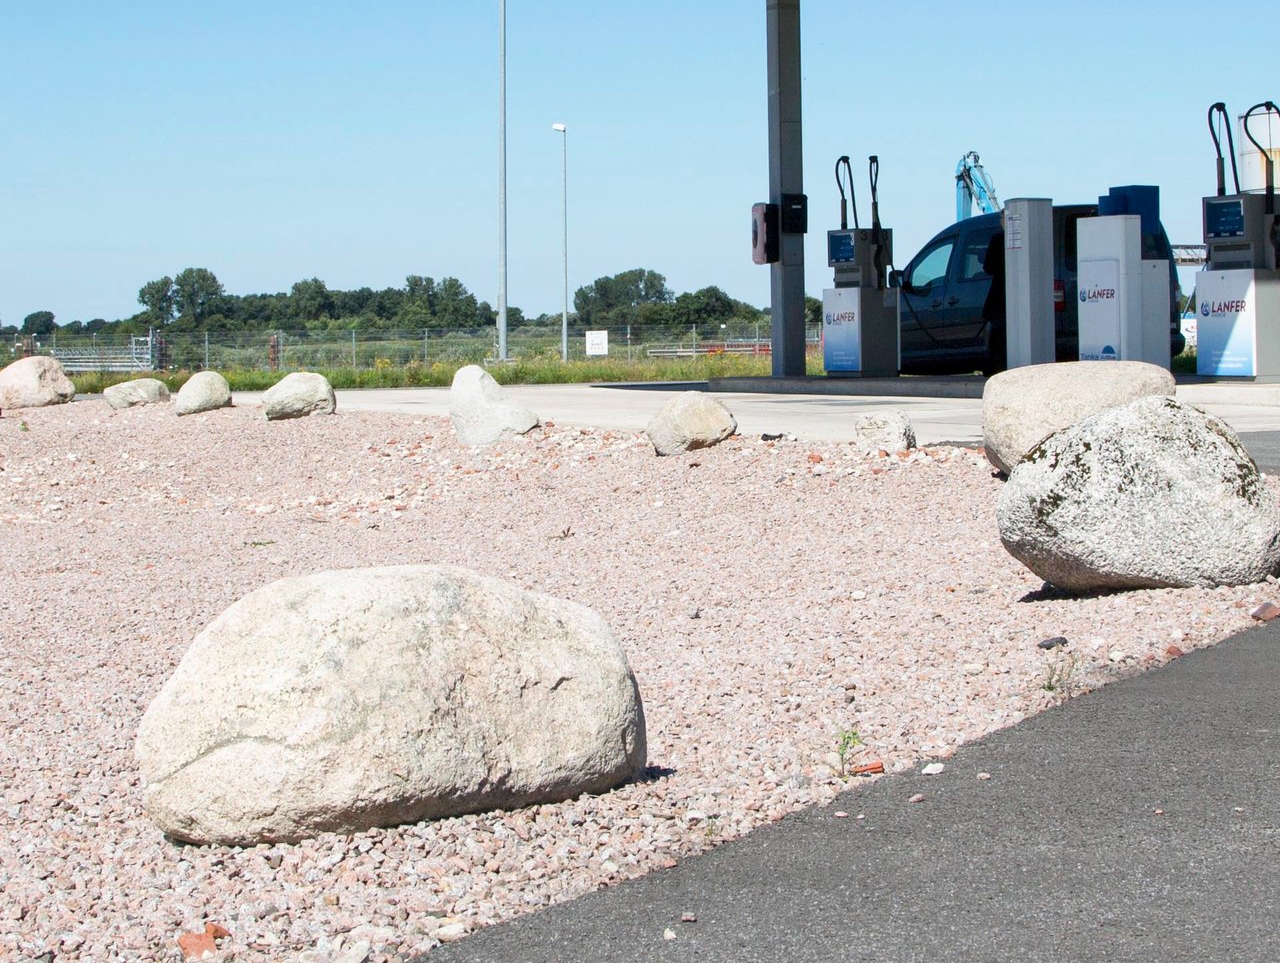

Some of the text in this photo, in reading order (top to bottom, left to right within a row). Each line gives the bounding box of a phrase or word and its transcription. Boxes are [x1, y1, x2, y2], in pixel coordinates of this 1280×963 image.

[1088, 289, 1115, 299] LANFER
[1211, 300, 1247, 314] LANFER
[832, 311, 855, 323] LANFER
